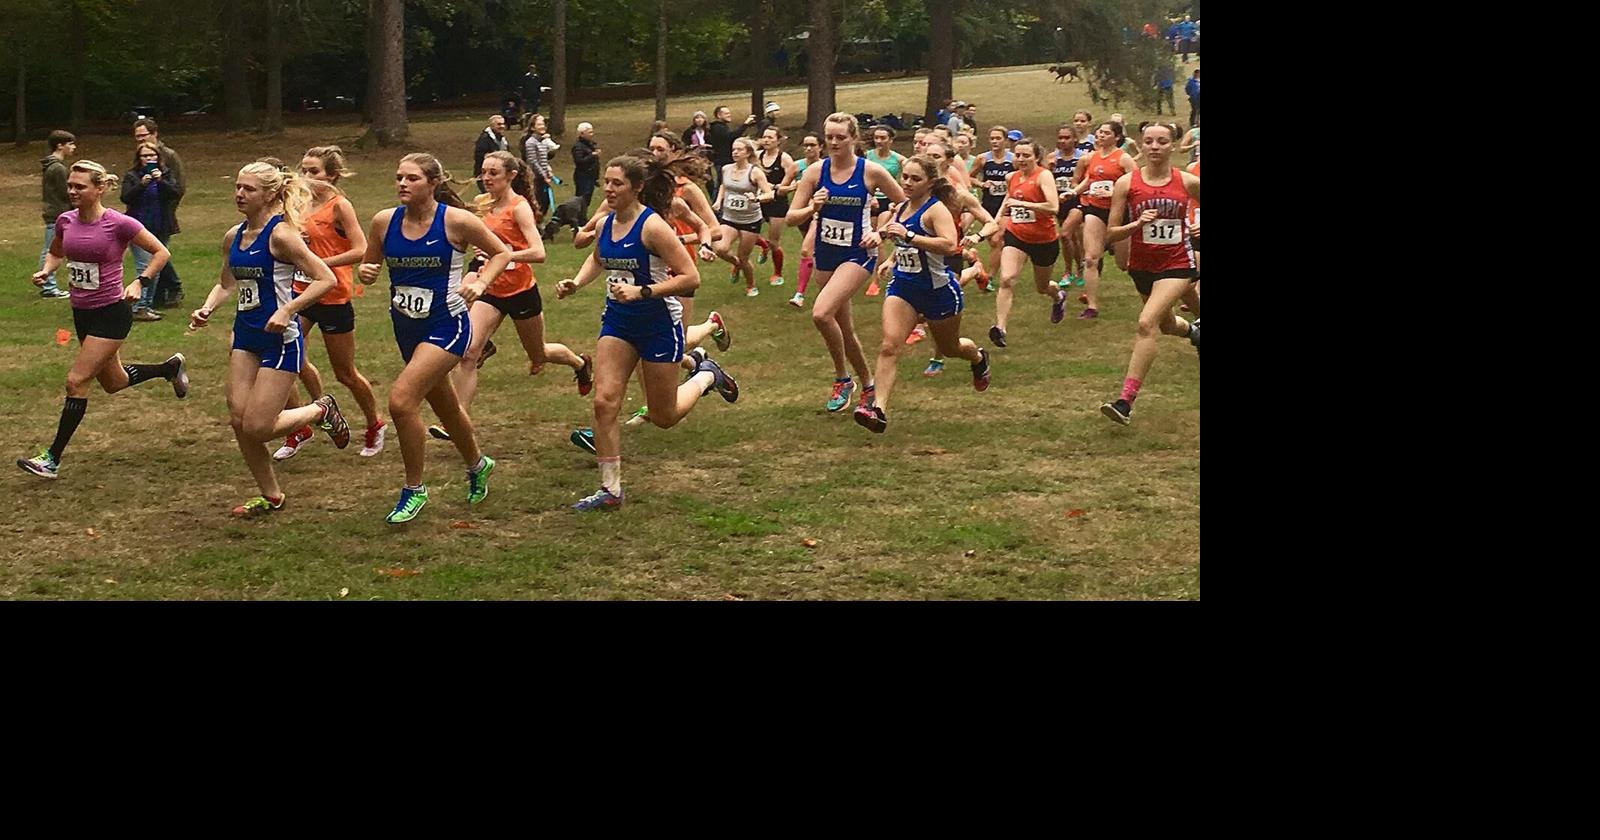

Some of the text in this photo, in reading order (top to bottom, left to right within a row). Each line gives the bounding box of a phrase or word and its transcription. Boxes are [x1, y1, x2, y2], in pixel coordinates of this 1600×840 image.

[824, 225, 845, 240] 211
[1150, 225, 1175, 239] 317
[399, 293, 424, 312] 210
